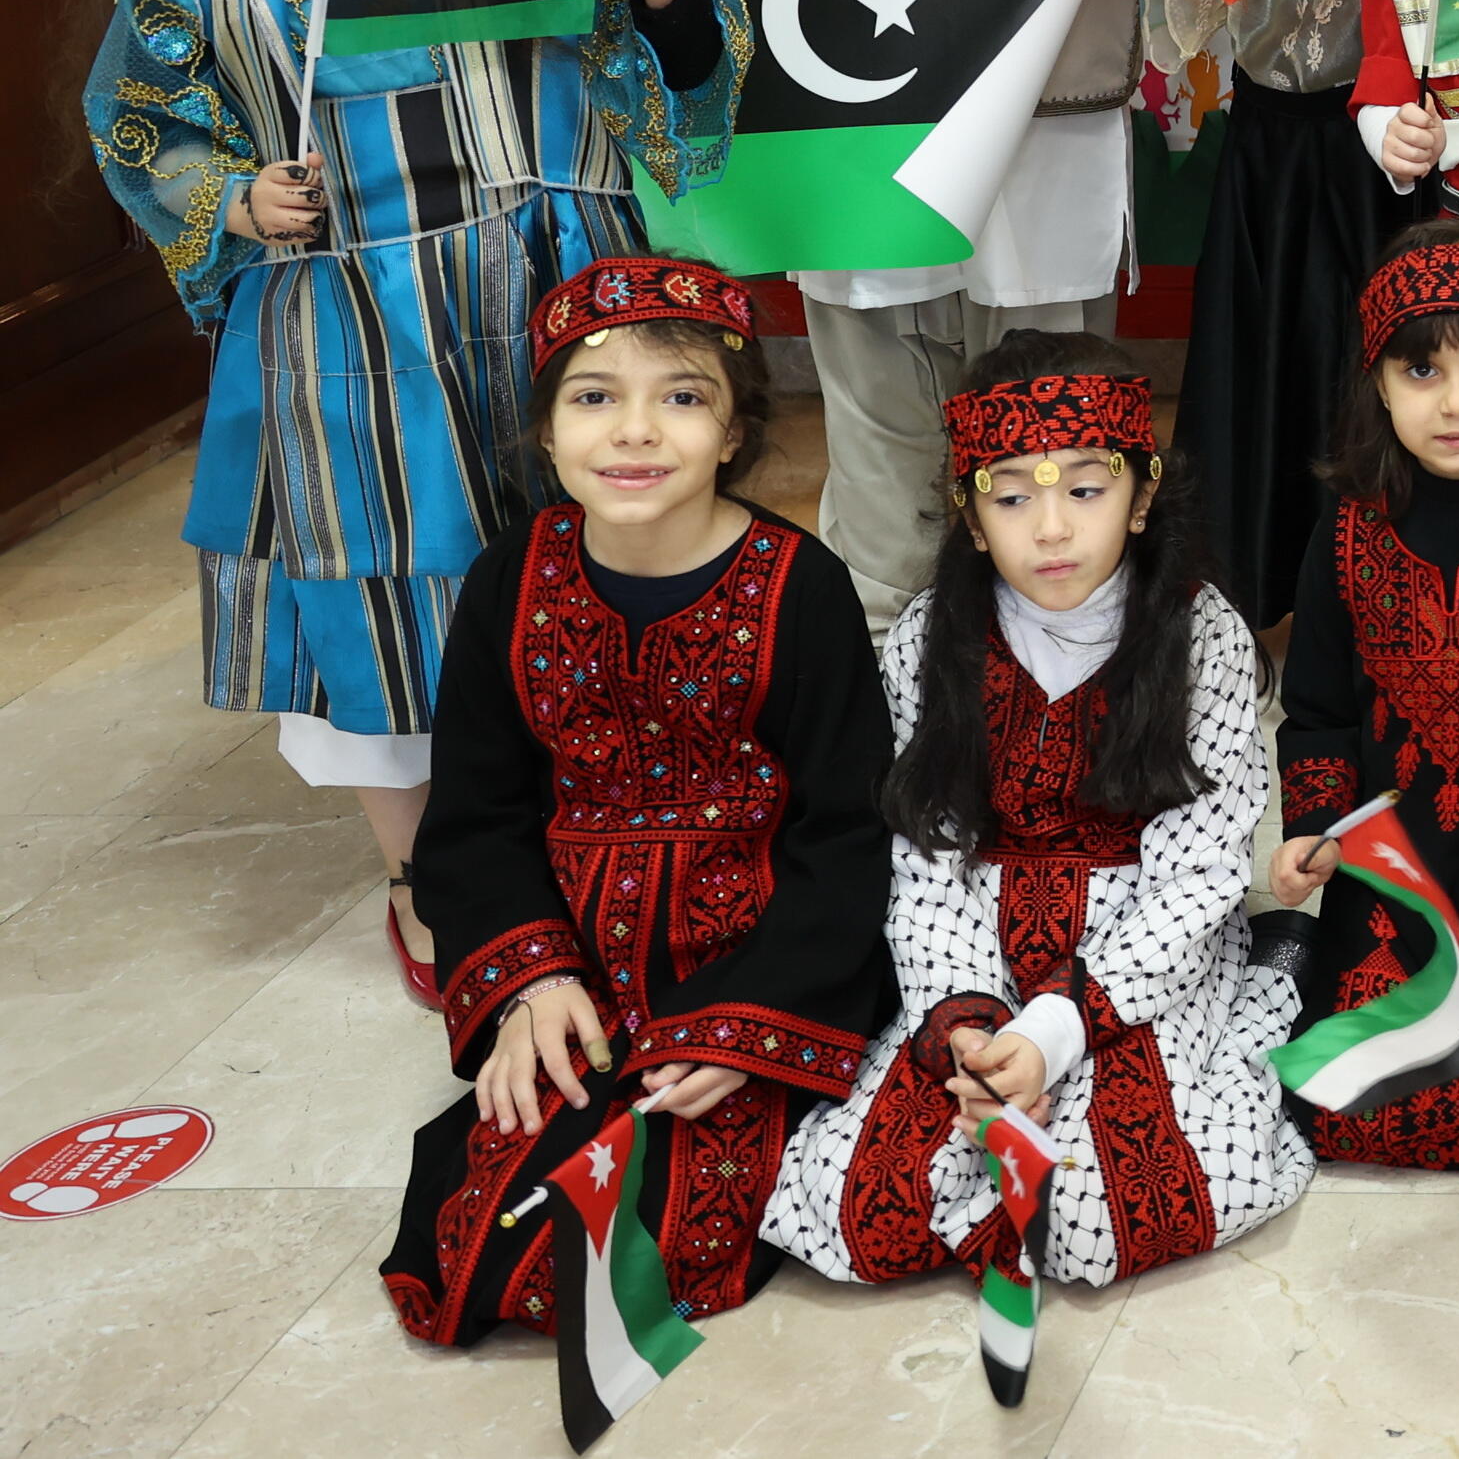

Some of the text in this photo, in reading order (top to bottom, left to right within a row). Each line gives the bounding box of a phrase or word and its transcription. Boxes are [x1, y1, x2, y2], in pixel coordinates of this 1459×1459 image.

[60, 1144, 115, 1181] HERE
[89, 1144, 140, 1180] WAIT
[101, 1137, 173, 1189] PLEASE
